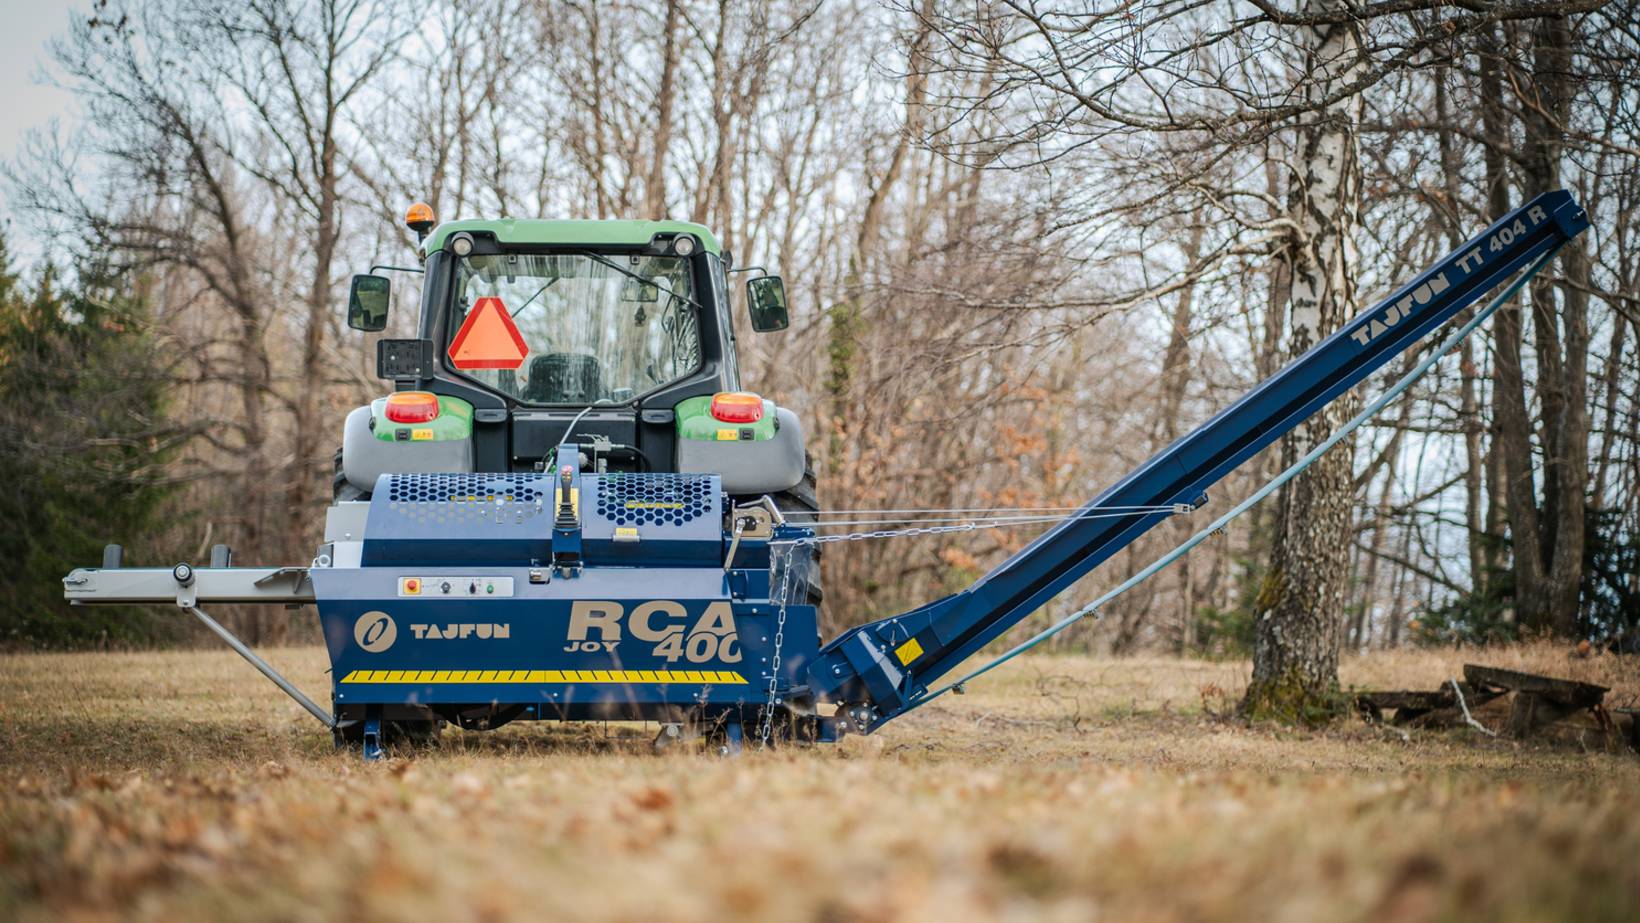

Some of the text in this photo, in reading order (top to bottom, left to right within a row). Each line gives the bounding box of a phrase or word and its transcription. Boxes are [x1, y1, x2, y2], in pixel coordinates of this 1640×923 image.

[1351, 205, 1548, 346] TAJFUN TT 404 R
[410, 623, 510, 639] TAJFUN
[567, 600, 737, 642] RCA
[563, 641, 621, 653] JOY
[652, 631, 743, 663] 400
